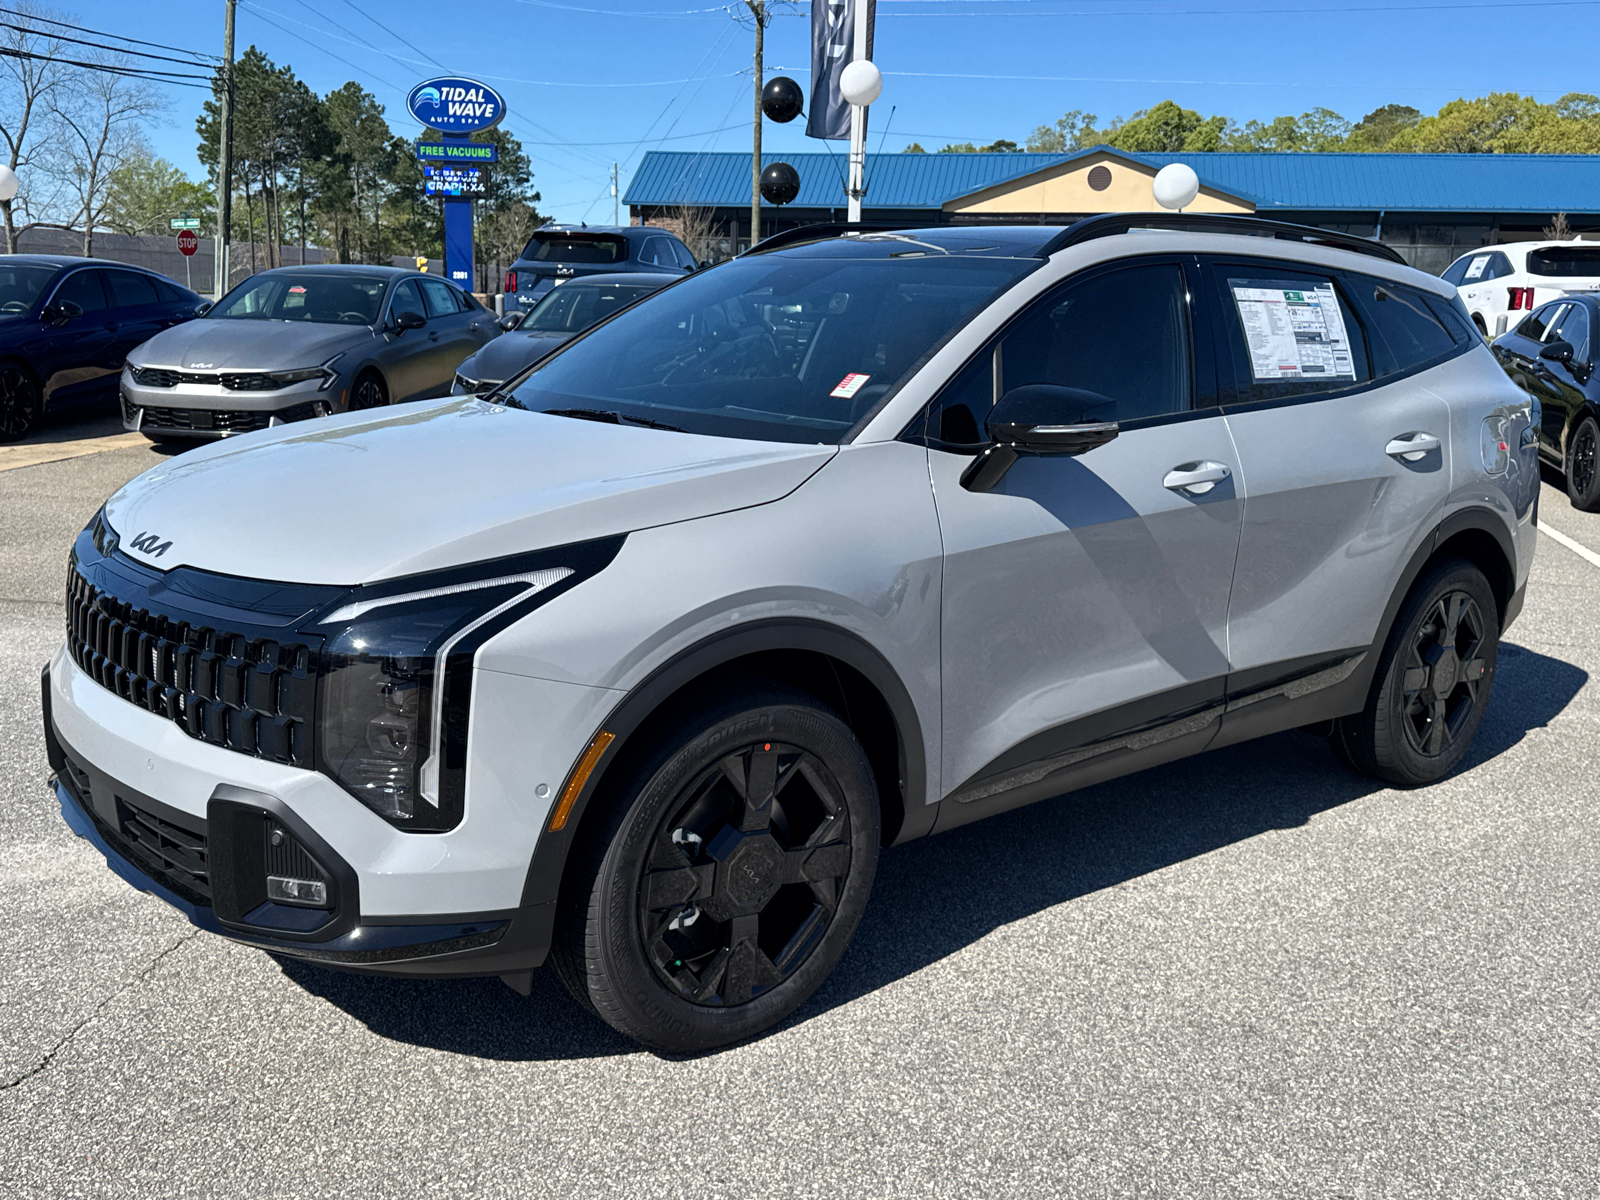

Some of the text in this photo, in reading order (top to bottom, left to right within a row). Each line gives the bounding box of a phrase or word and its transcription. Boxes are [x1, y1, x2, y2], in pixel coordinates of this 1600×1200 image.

[441, 87, 485, 102] TIDAL
[448, 102, 495, 117] WAVE
[420, 146, 491, 158] FREE VACUUMS
[178, 237, 197, 248] STOP
[129, 531, 173, 558] KIA
